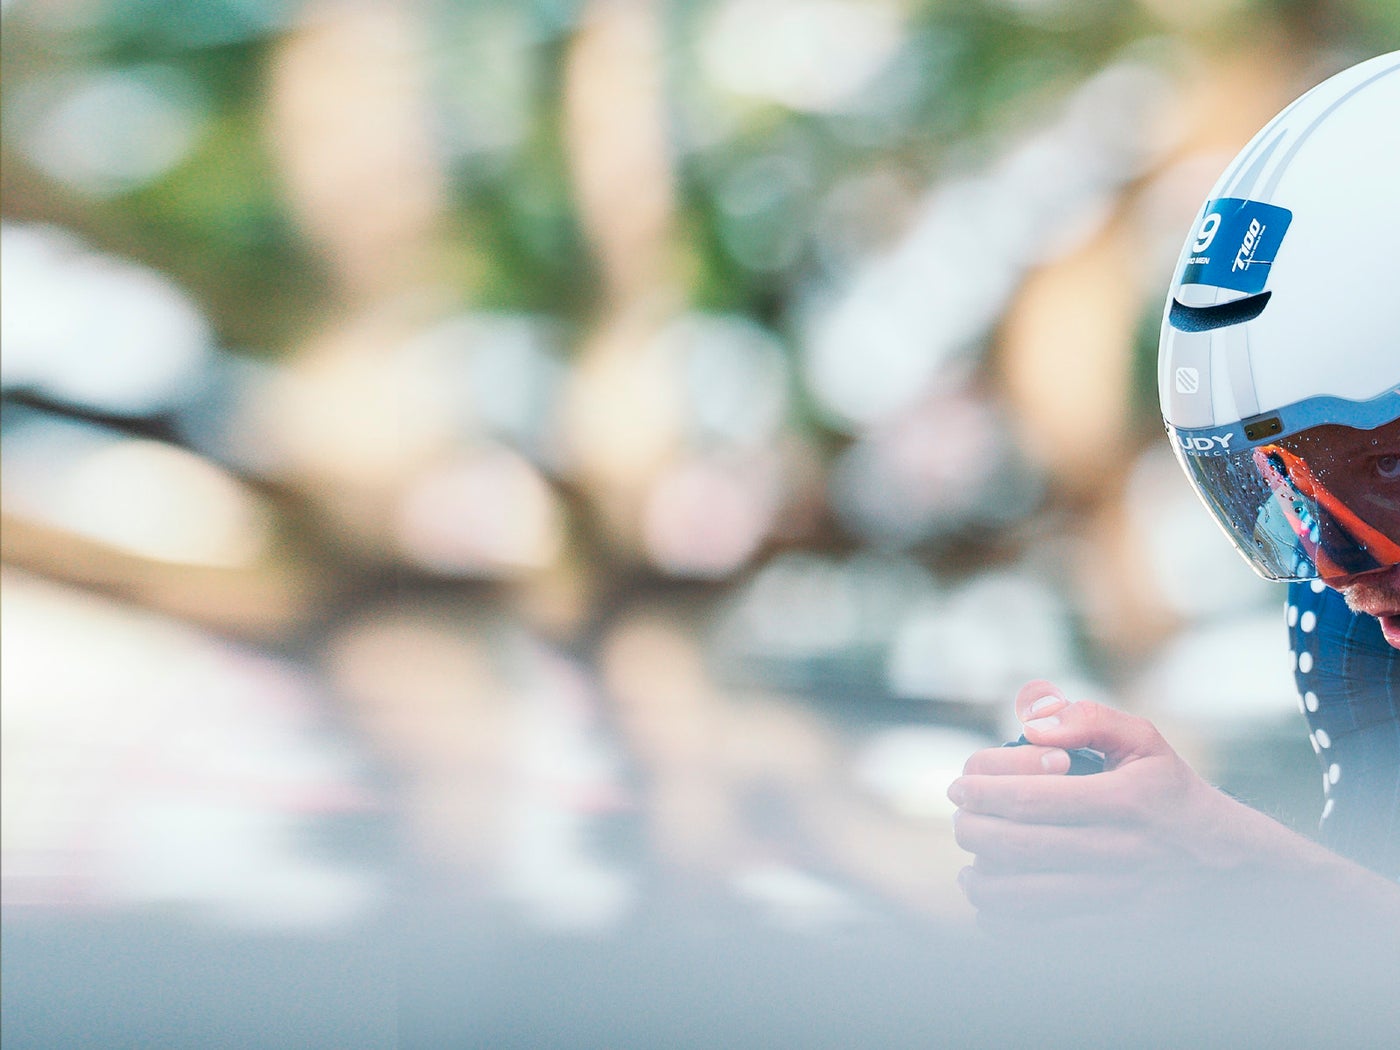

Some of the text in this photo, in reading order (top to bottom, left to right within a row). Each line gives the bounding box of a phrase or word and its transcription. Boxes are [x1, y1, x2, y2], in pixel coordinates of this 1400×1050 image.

[1192, 213, 1221, 253] 9
[1232, 218, 1260, 272] T100
[1176, 432, 1234, 450] UDY
